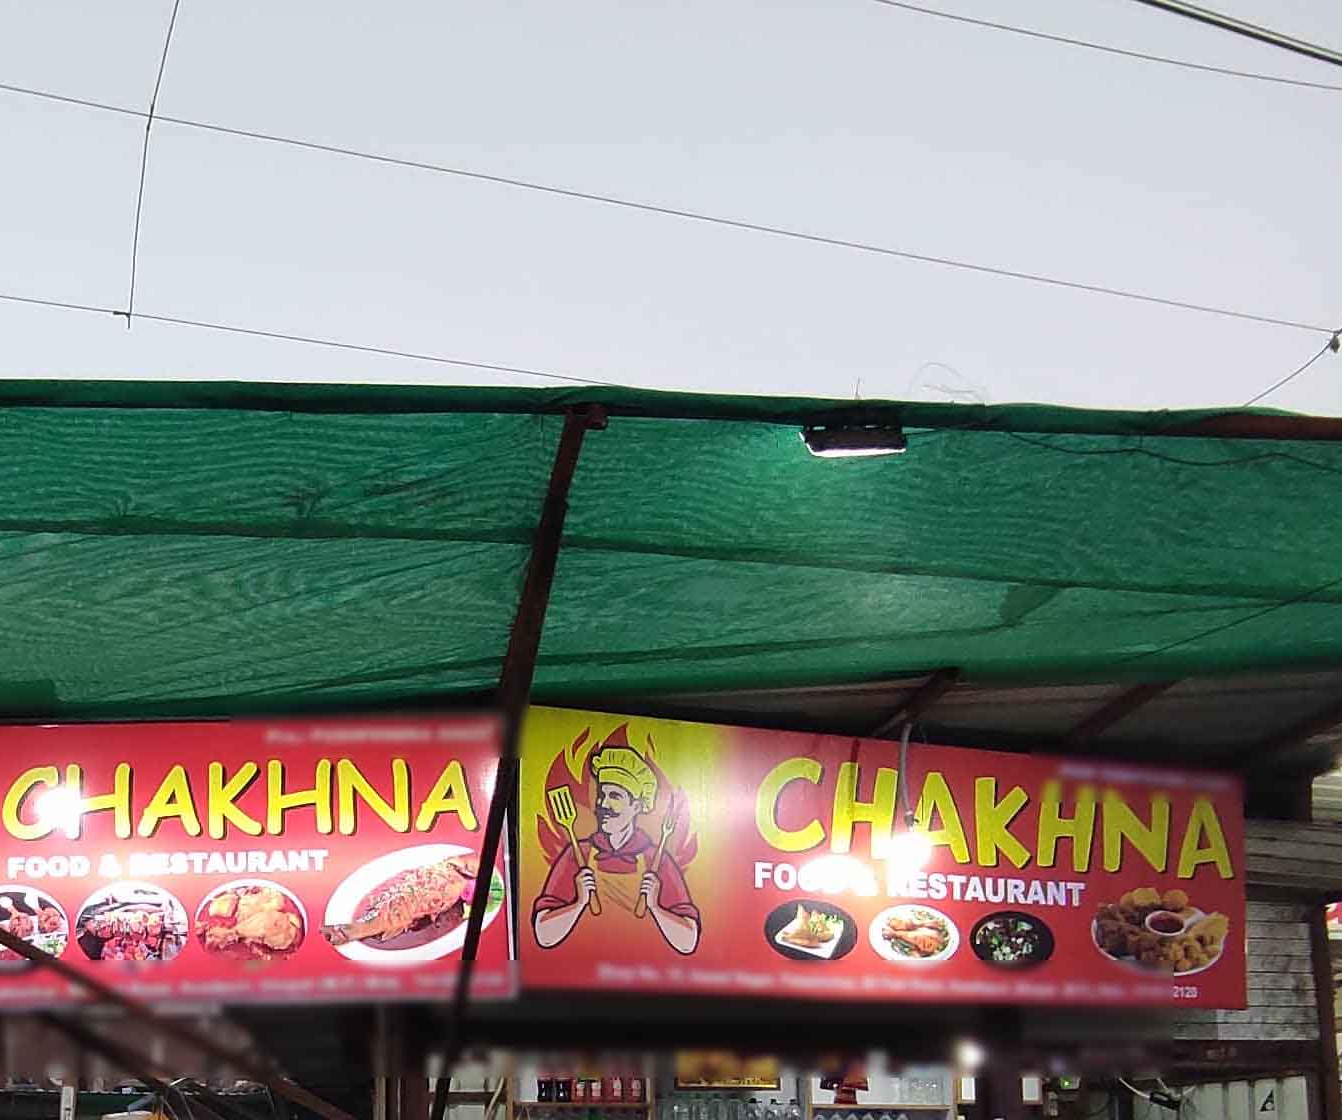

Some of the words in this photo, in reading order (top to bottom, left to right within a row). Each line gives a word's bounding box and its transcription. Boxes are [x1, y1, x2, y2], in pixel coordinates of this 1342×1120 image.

[1, 758, 479, 841] CHAKHNA
[755, 757, 1235, 880] CHAKHNA
[7, 855, 90, 879] FOOD
